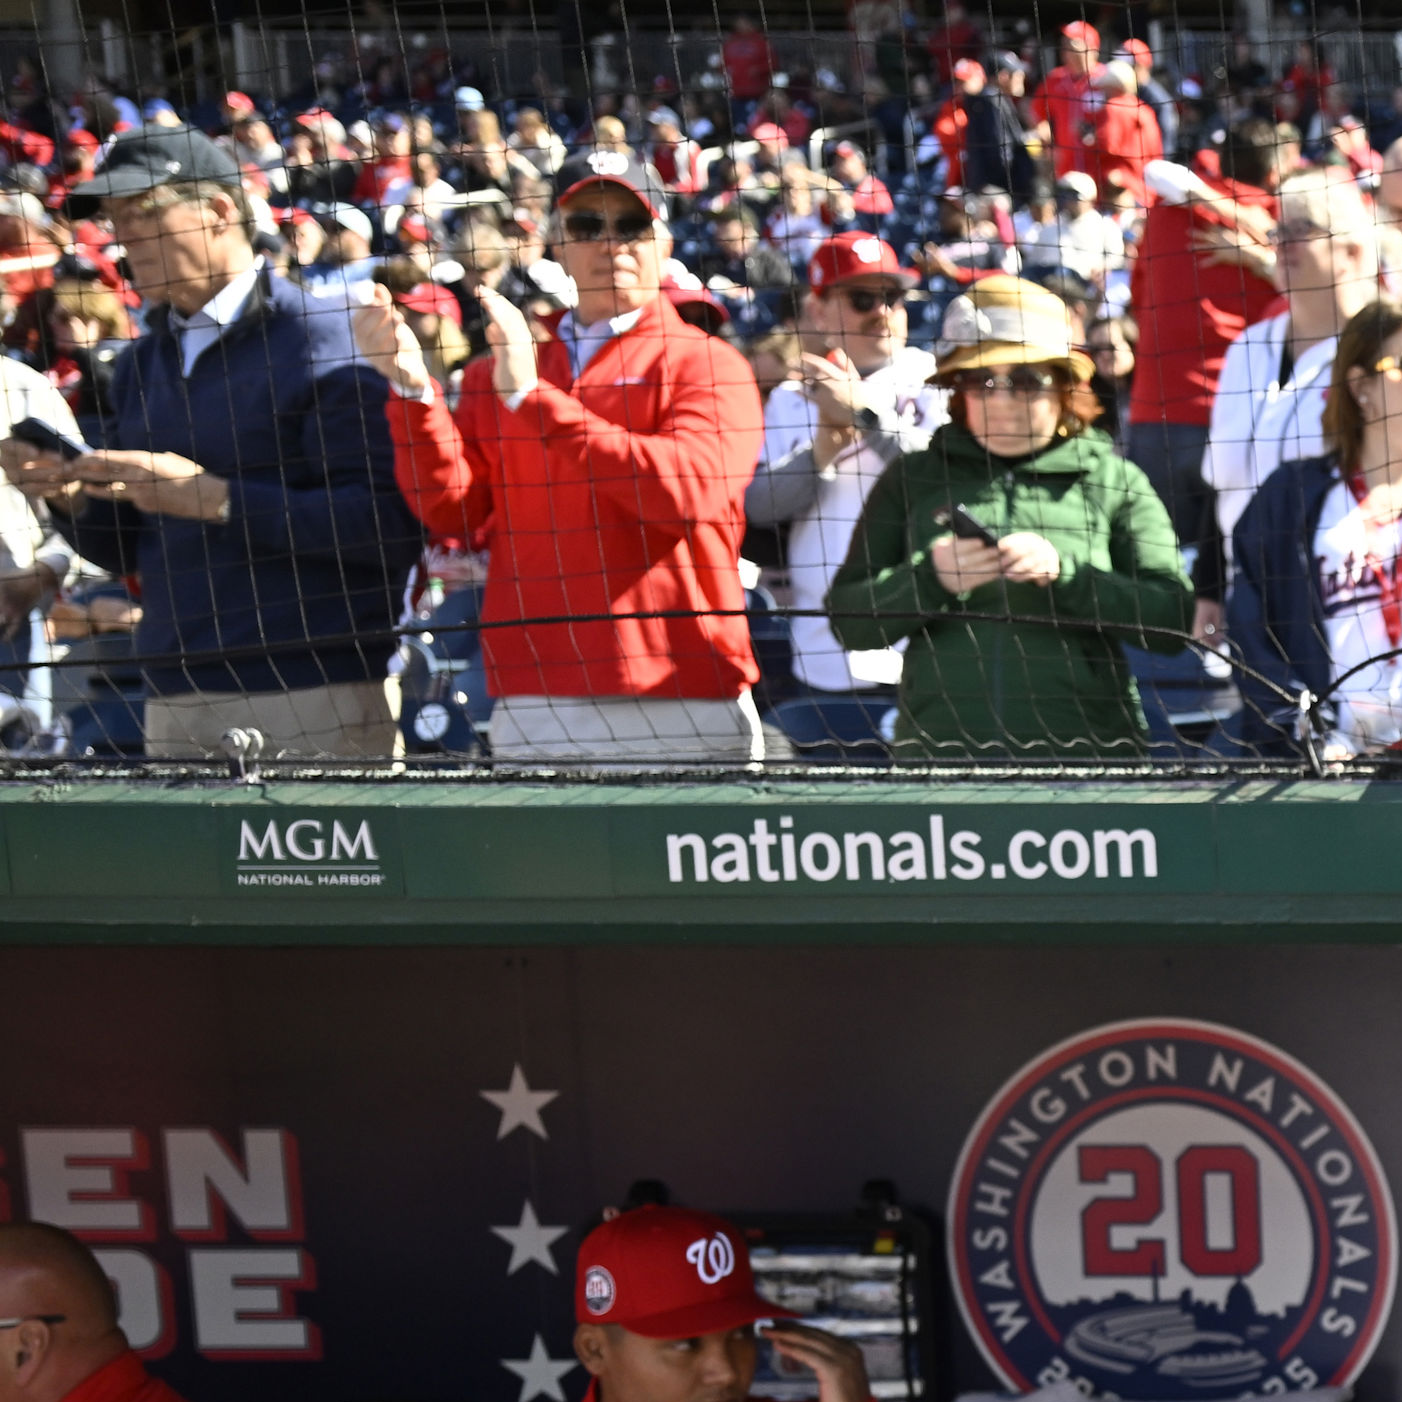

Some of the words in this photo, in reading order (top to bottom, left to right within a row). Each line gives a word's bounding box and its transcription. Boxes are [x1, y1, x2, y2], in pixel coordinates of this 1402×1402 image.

[237, 819, 379, 861] MGM
[237, 873, 313, 886] NATIONAL
[666, 815, 1159, 883] nationals.com
[20, 1127, 295, 1234] EN
[973, 1045, 1177, 1343] WASHINGTON
[1208, 1052, 1371, 1338] NATIONALS
[1078, 1144, 1263, 1279] 20
